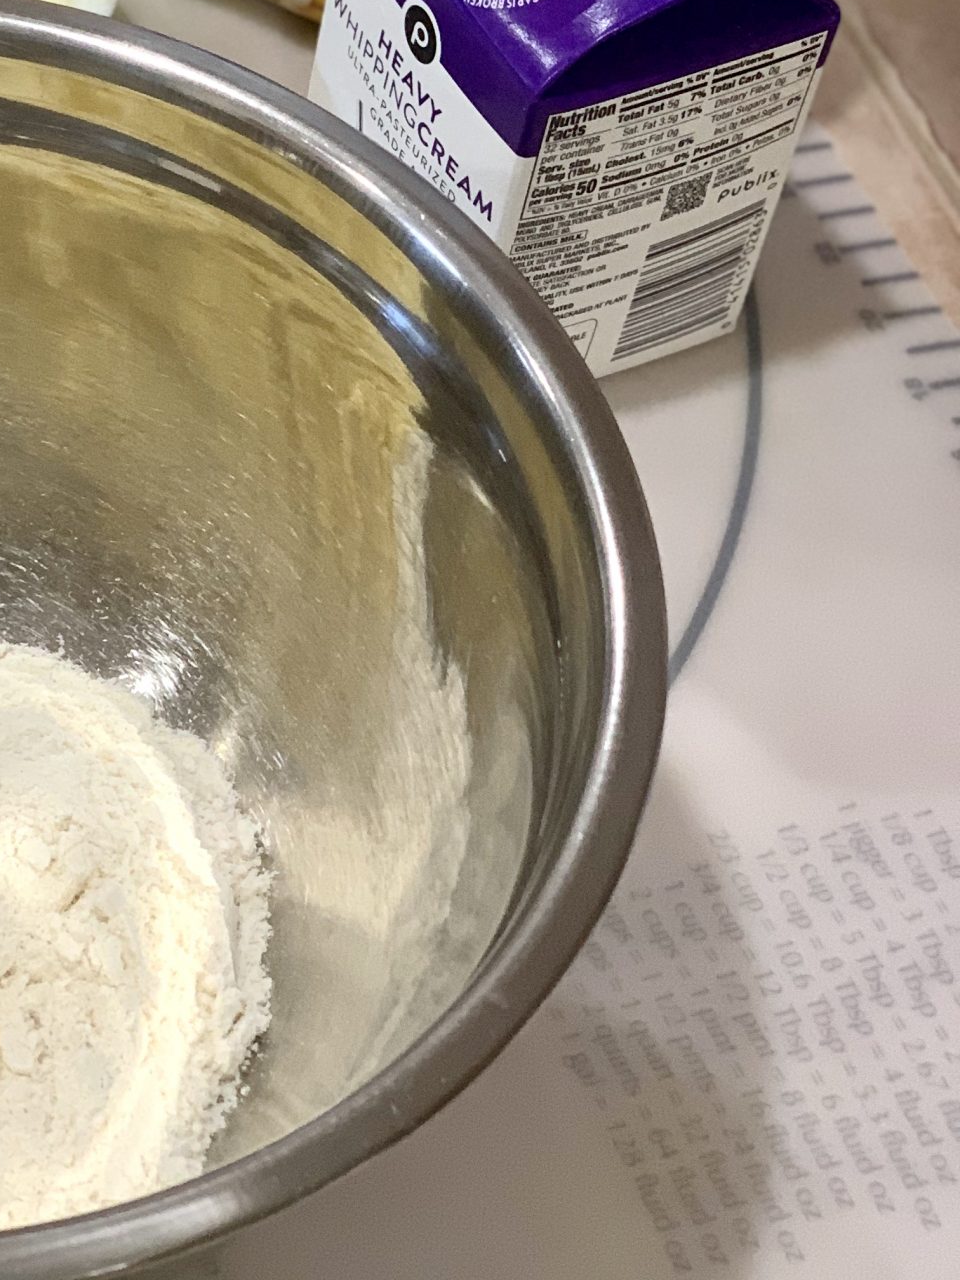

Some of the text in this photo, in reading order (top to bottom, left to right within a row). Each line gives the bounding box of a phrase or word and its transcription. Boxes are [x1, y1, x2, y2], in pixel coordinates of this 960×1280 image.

[378, 28, 443, 124] HEAVY
[710, 80, 736, 95] Total
[738, 71, 765, 84] Carb.
[802, 52, 818, 63] 0%
[713, 52, 775, 76] Amount/serving
[620, 80, 684, 105] Amount/serving
[713, 90, 748, 109] Dietary
[797, 66, 812, 77] 0%
[549, 103, 617, 130] Nutrition
[618, 90, 707, 124] Total Fat 5g 7%
[641, 119, 657, 131] Fat
[658, 111, 679, 126] 3.5g
[680, 104, 703, 119] 17%
[711, 96, 767, 123] Total Sugars
[347, 45, 457, 204] ULTRA-PASTEURIZED
[369, 107, 406, 162] GRADE
[545, 123, 587, 143] Facts
[647, 130, 664, 144] Fat
[540, 143, 606, 165] per container
[543, 135, 601, 155] 32 servings
[605, 151, 647, 169] Cholest.
[692, 137, 730, 157] Protein
[601, 167, 642, 184] Sodium
[673, 151, 690, 164] 0%
[531, 178, 598, 199] Calories 50
[514, 238, 558, 253] CONTAINS
[903, 852, 939, 893] cup
[799, 863, 834, 903] cup
[855, 951, 896, 1008] Tbsp
[841, 870, 876, 910] cup
[897, 958, 938, 1018] Tbsp
[915, 927, 955, 985] Tbsp
[731, 871, 764, 912] cup
[807, 992, 846, 1054] Tbsp
[914, 1196, 942, 1230] oz
[779, 889, 812, 930] cup
[835, 976, 875, 1036] Tbsp
[894, 1089, 945, 1148] fluid
[929, 1153, 958, 1184] oz
[773, 1002, 813, 1063] Tbsp
[868, 1180, 896, 1213] oz
[795, 1186, 823, 1220] oz
[827, 1176, 856, 1208] oz
[777, 1229, 806, 1262] oz
